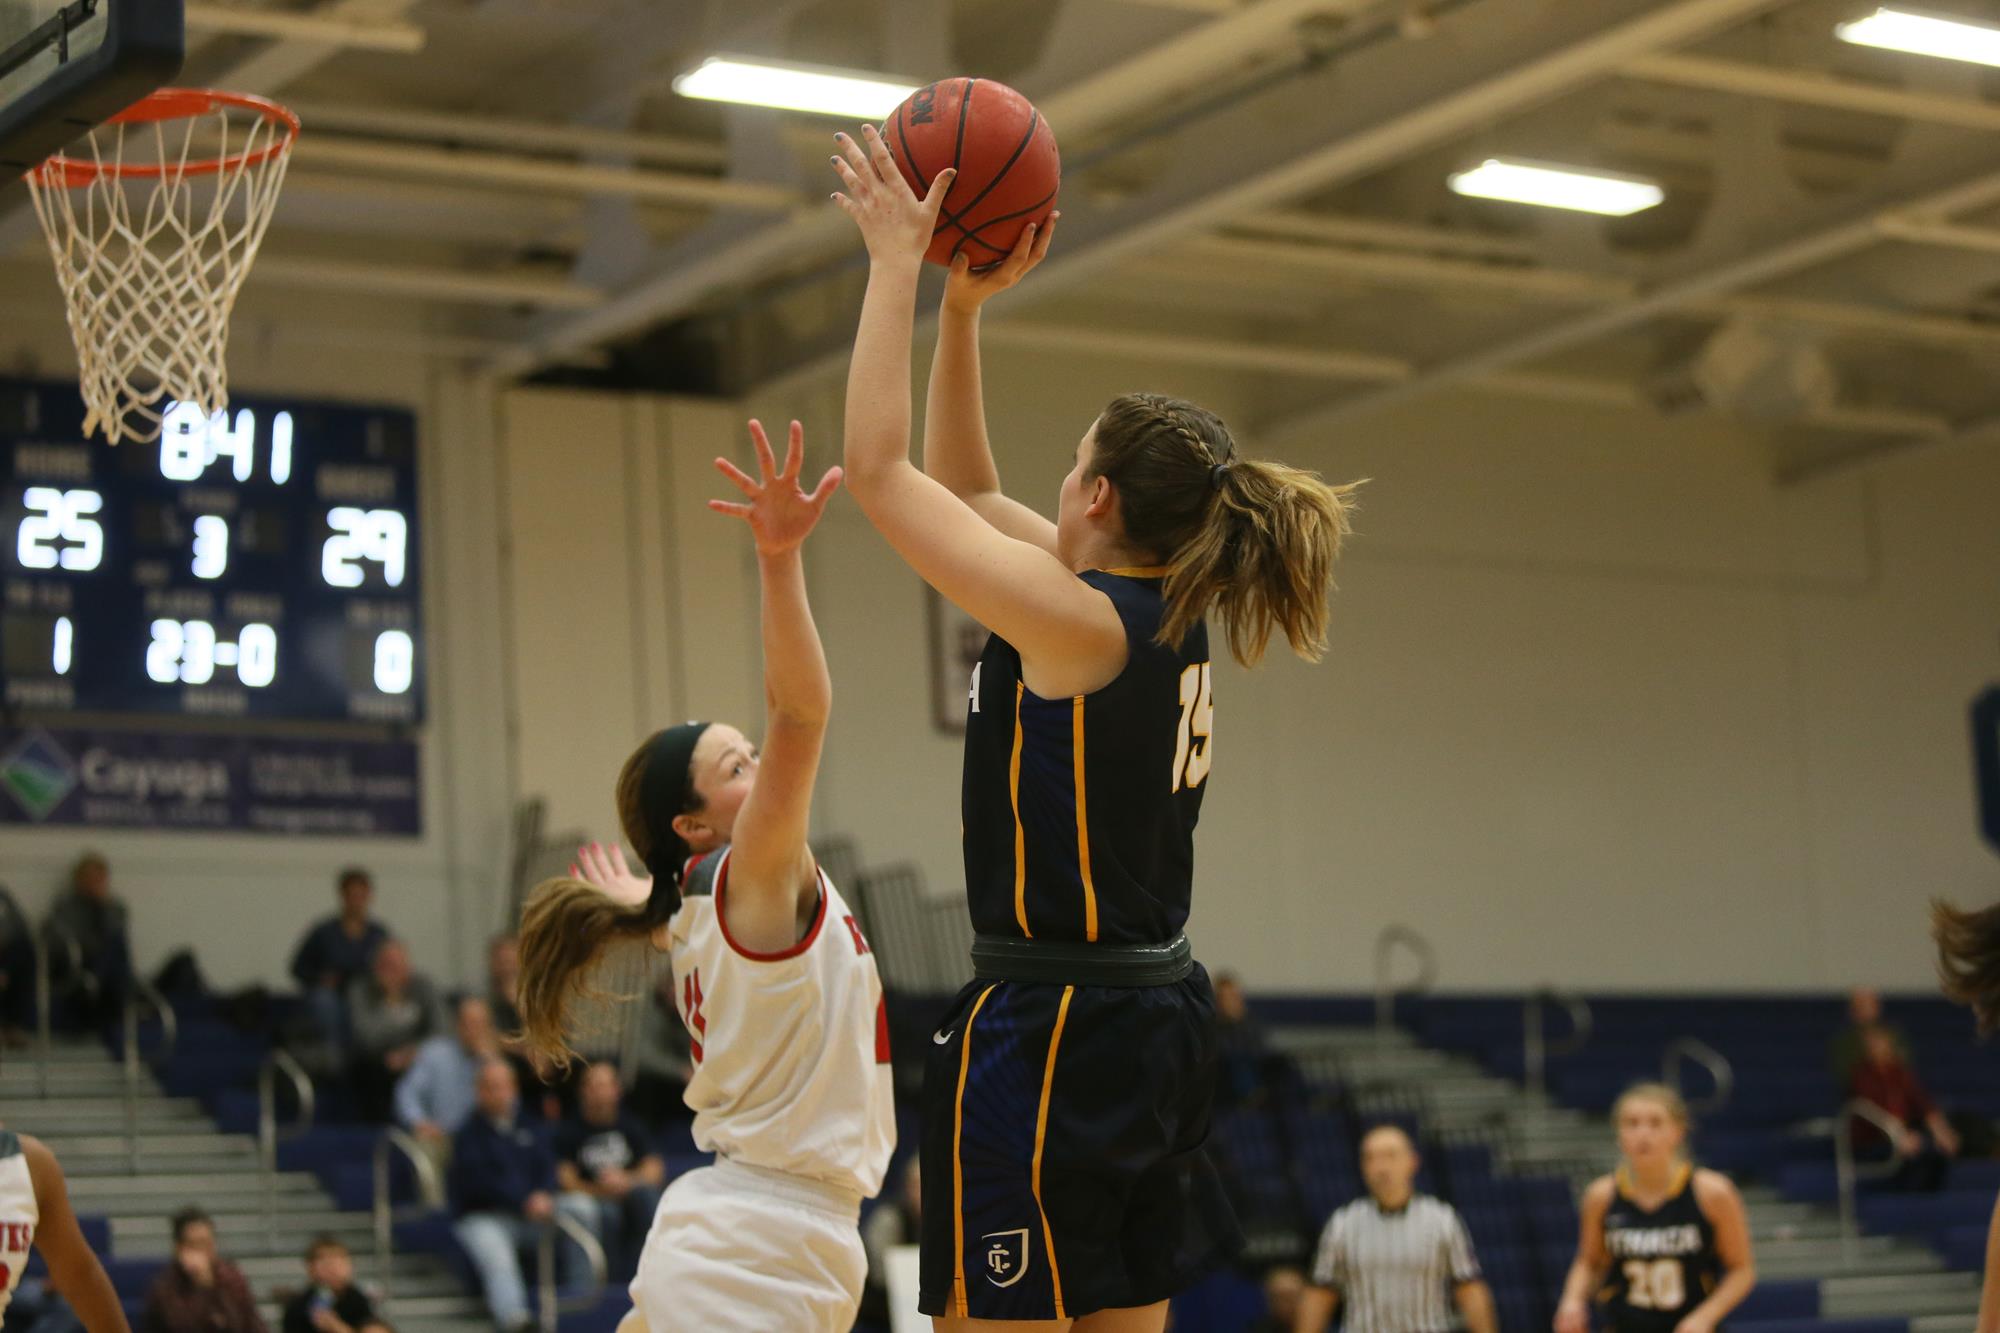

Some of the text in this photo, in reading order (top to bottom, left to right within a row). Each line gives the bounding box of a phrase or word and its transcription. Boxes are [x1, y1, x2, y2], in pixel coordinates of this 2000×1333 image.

[17, 487, 103, 571] 25
[191, 515, 228, 579] 3
[321, 507, 407, 588] 29
[53, 616, 73, 675] 1
[374, 630, 413, 694] 0
[1622, 1258, 1685, 1309] 20
